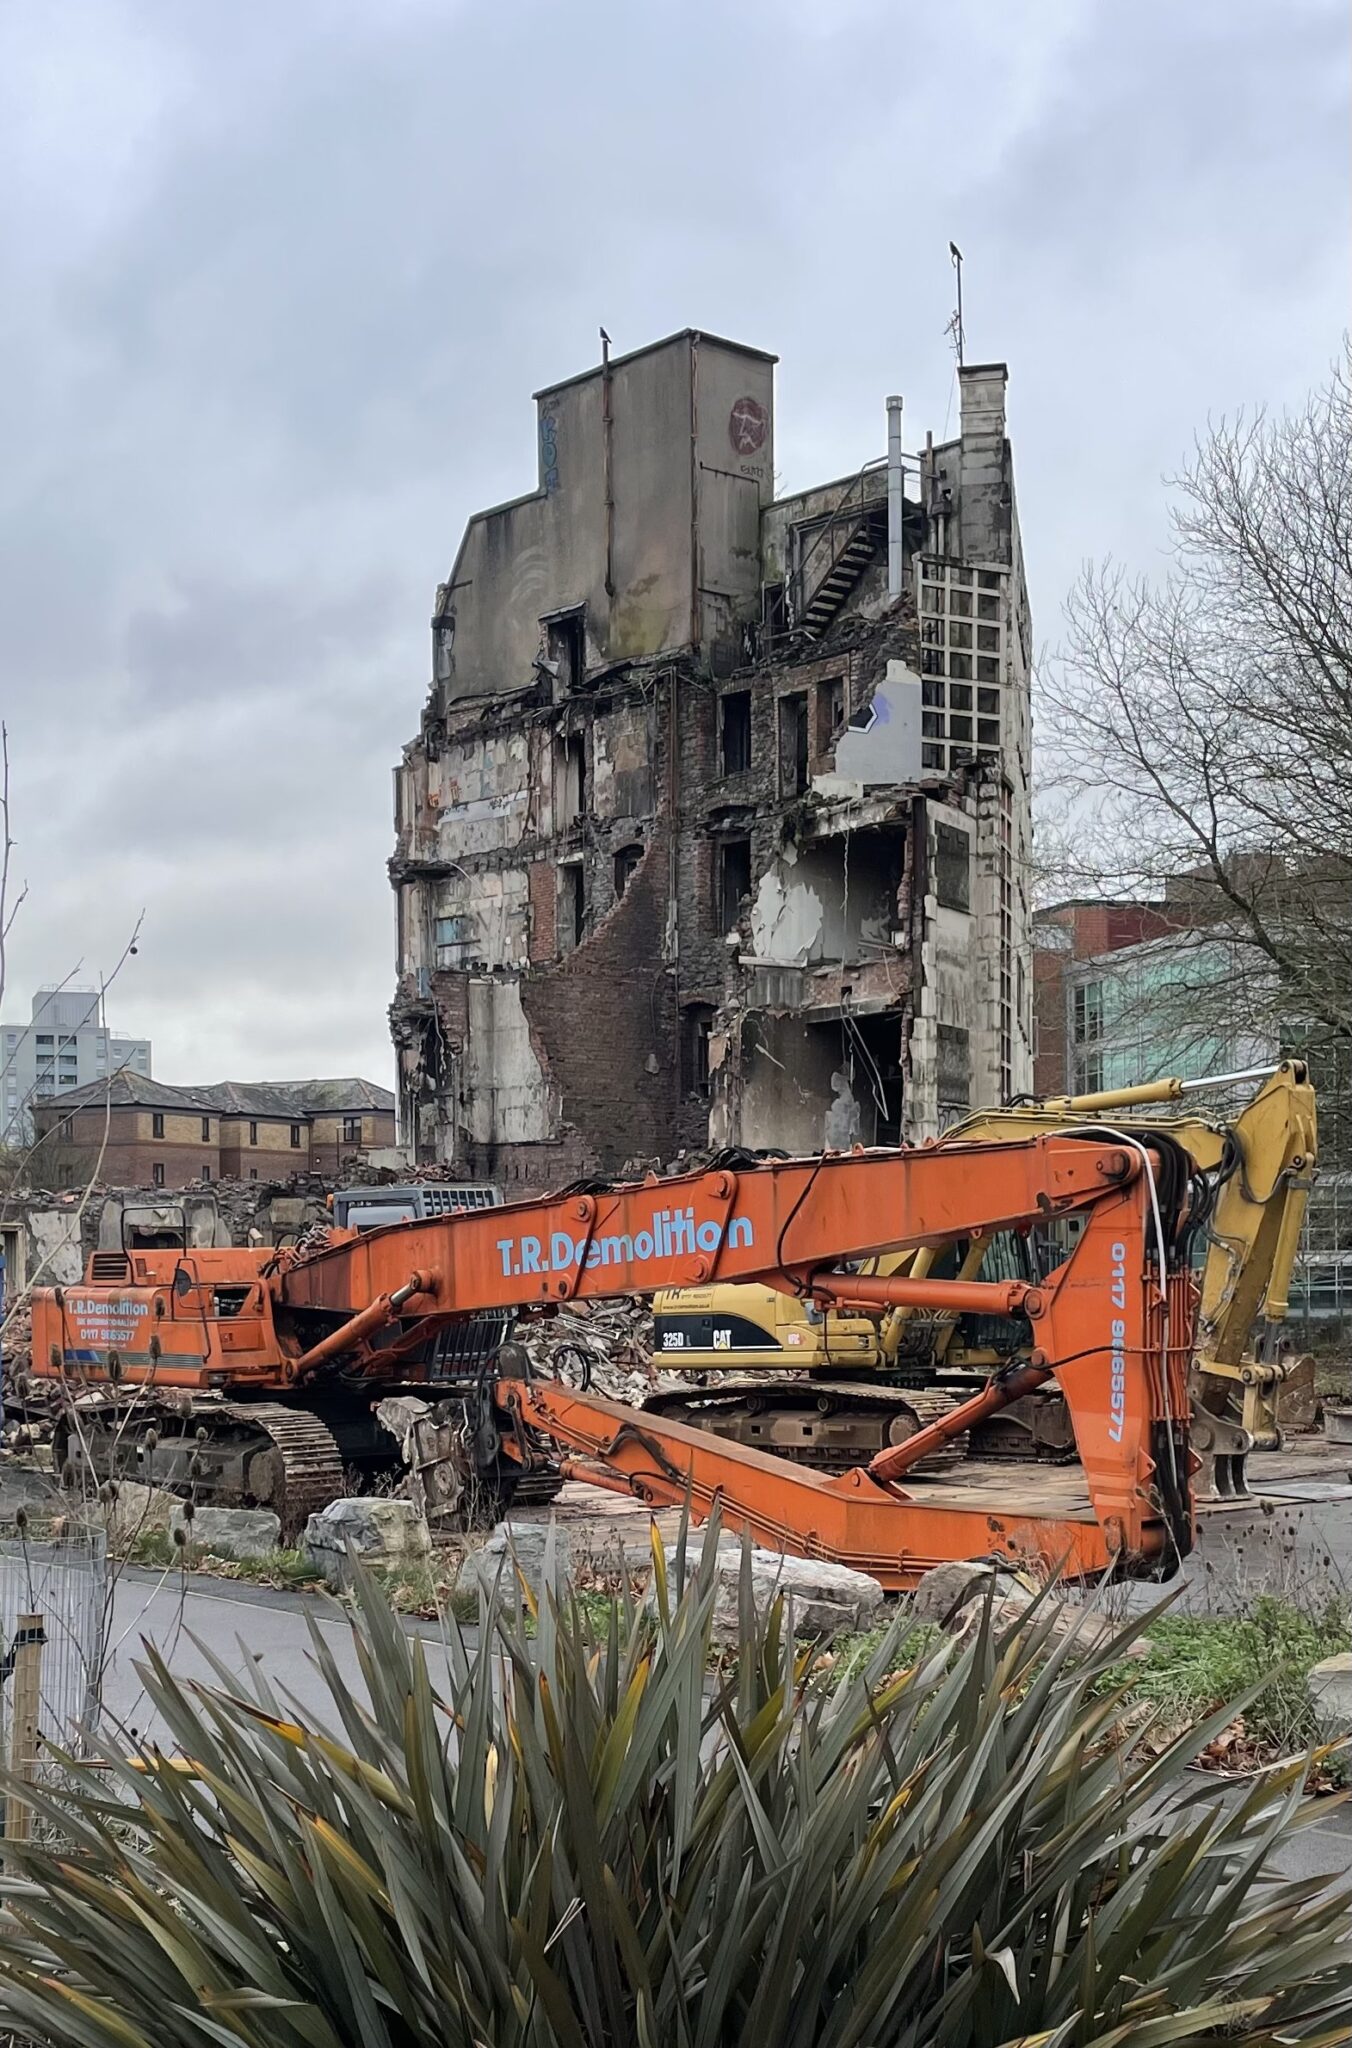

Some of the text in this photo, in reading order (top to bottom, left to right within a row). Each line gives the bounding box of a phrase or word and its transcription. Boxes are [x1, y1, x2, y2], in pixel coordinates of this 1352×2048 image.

[497, 1207, 754, 1276] T.R.Demolition
[1111, 1242, 1126, 1309] 0117
[67, 1297, 148, 1316] T.R.Demolition
[80, 1329, 99, 1339] 0117
[663, 1332, 684, 1347] 325D
[713, 1330, 732, 1349] CAT
